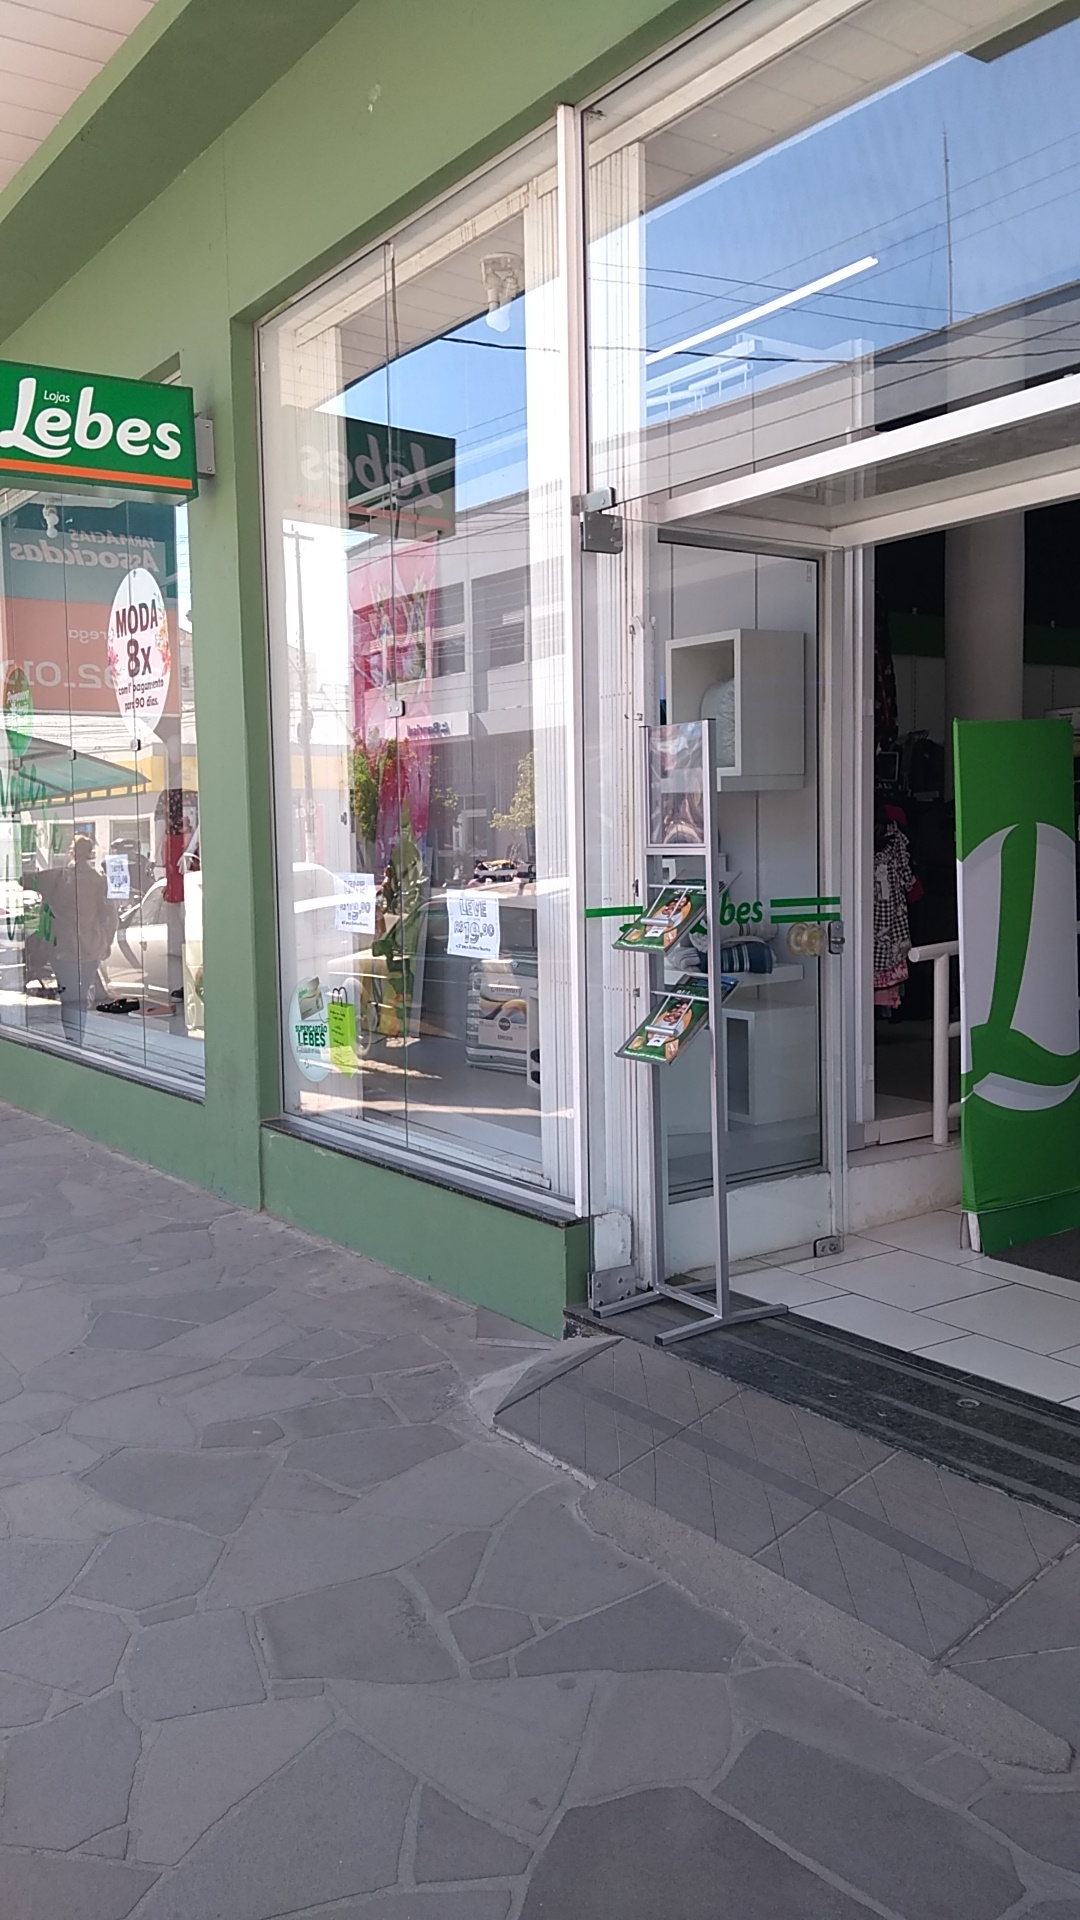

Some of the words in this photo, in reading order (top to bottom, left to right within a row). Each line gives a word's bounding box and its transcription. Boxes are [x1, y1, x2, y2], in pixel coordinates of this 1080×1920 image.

[43, 389, 70, 403] Lojas
[0, 377, 182, 460] Lebes
[116, 598, 159, 638] MODA
[135, 697, 145, 709] 90
[459, 898, 488, 918] LEVE
[298, 1032, 326, 1047] LEBES
